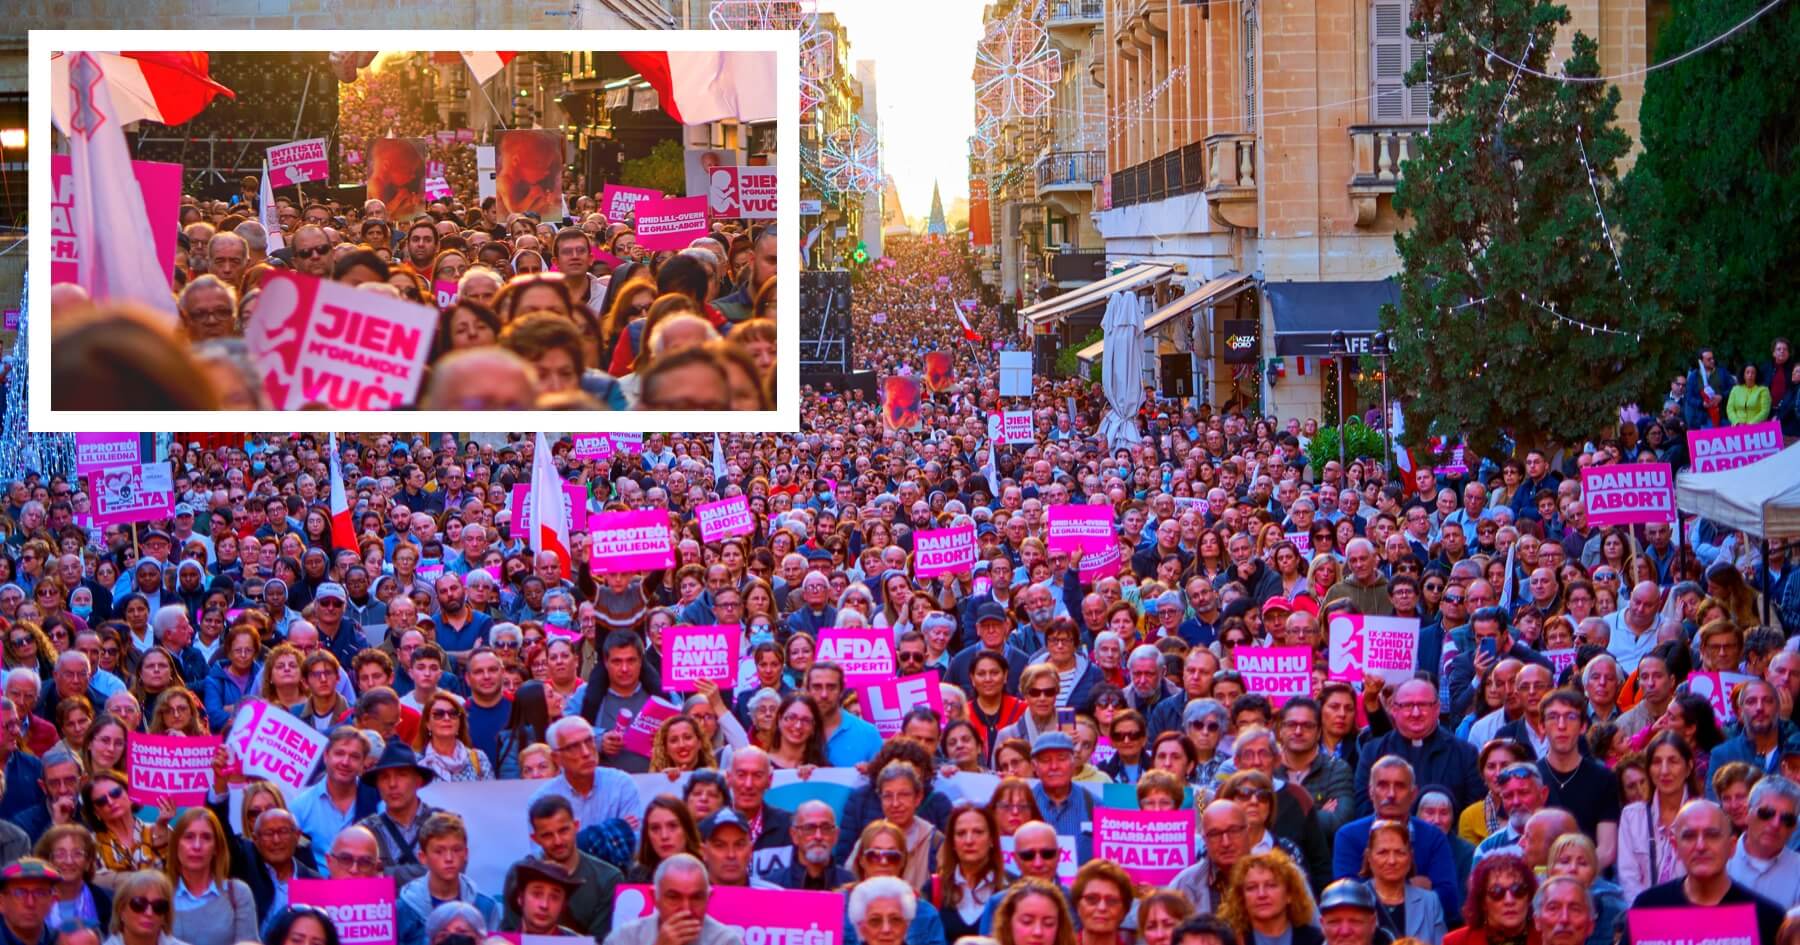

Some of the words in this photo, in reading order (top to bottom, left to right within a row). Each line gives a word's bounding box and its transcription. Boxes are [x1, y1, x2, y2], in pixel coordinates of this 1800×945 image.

[611, 200, 635, 211] FAV
[314, 304, 421, 361] JIEN
[1006, 416, 1030, 424] JIEN
[575, 437, 608, 448] AFDA
[1695, 435, 1743, 455] DAN
[1745, 431, 1776, 449] HU
[1588, 473, 1634, 490] DAN
[1636, 471, 1666, 488] HU
[1591, 491, 1667, 510] ABORT
[700, 505, 727, 520] DAN
[727, 501, 746, 515] HU
[704, 513, 748, 533] ABORT
[596, 543, 614, 554] LIL
[615, 540, 666, 553] ULIEDNA
[917, 535, 951, 549] DAN
[952, 531, 972, 546] HU
[920, 547, 971, 565] ABORT
[817, 637, 892, 659] AFDA
[1368, 648, 1412, 661] JIENA
[672, 650, 728, 666] FAVUR
[1237, 655, 1279, 671] DAN
[1280, 655, 1307, 671] HU
[867, 677, 931, 722] LE
[261, 717, 318, 759] JIEN
[141, 755, 181, 767] BARRA
[135, 768, 209, 790] MALTA
[1111, 830, 1153, 841] BARRA
[1104, 845, 1185, 866] MALTA
